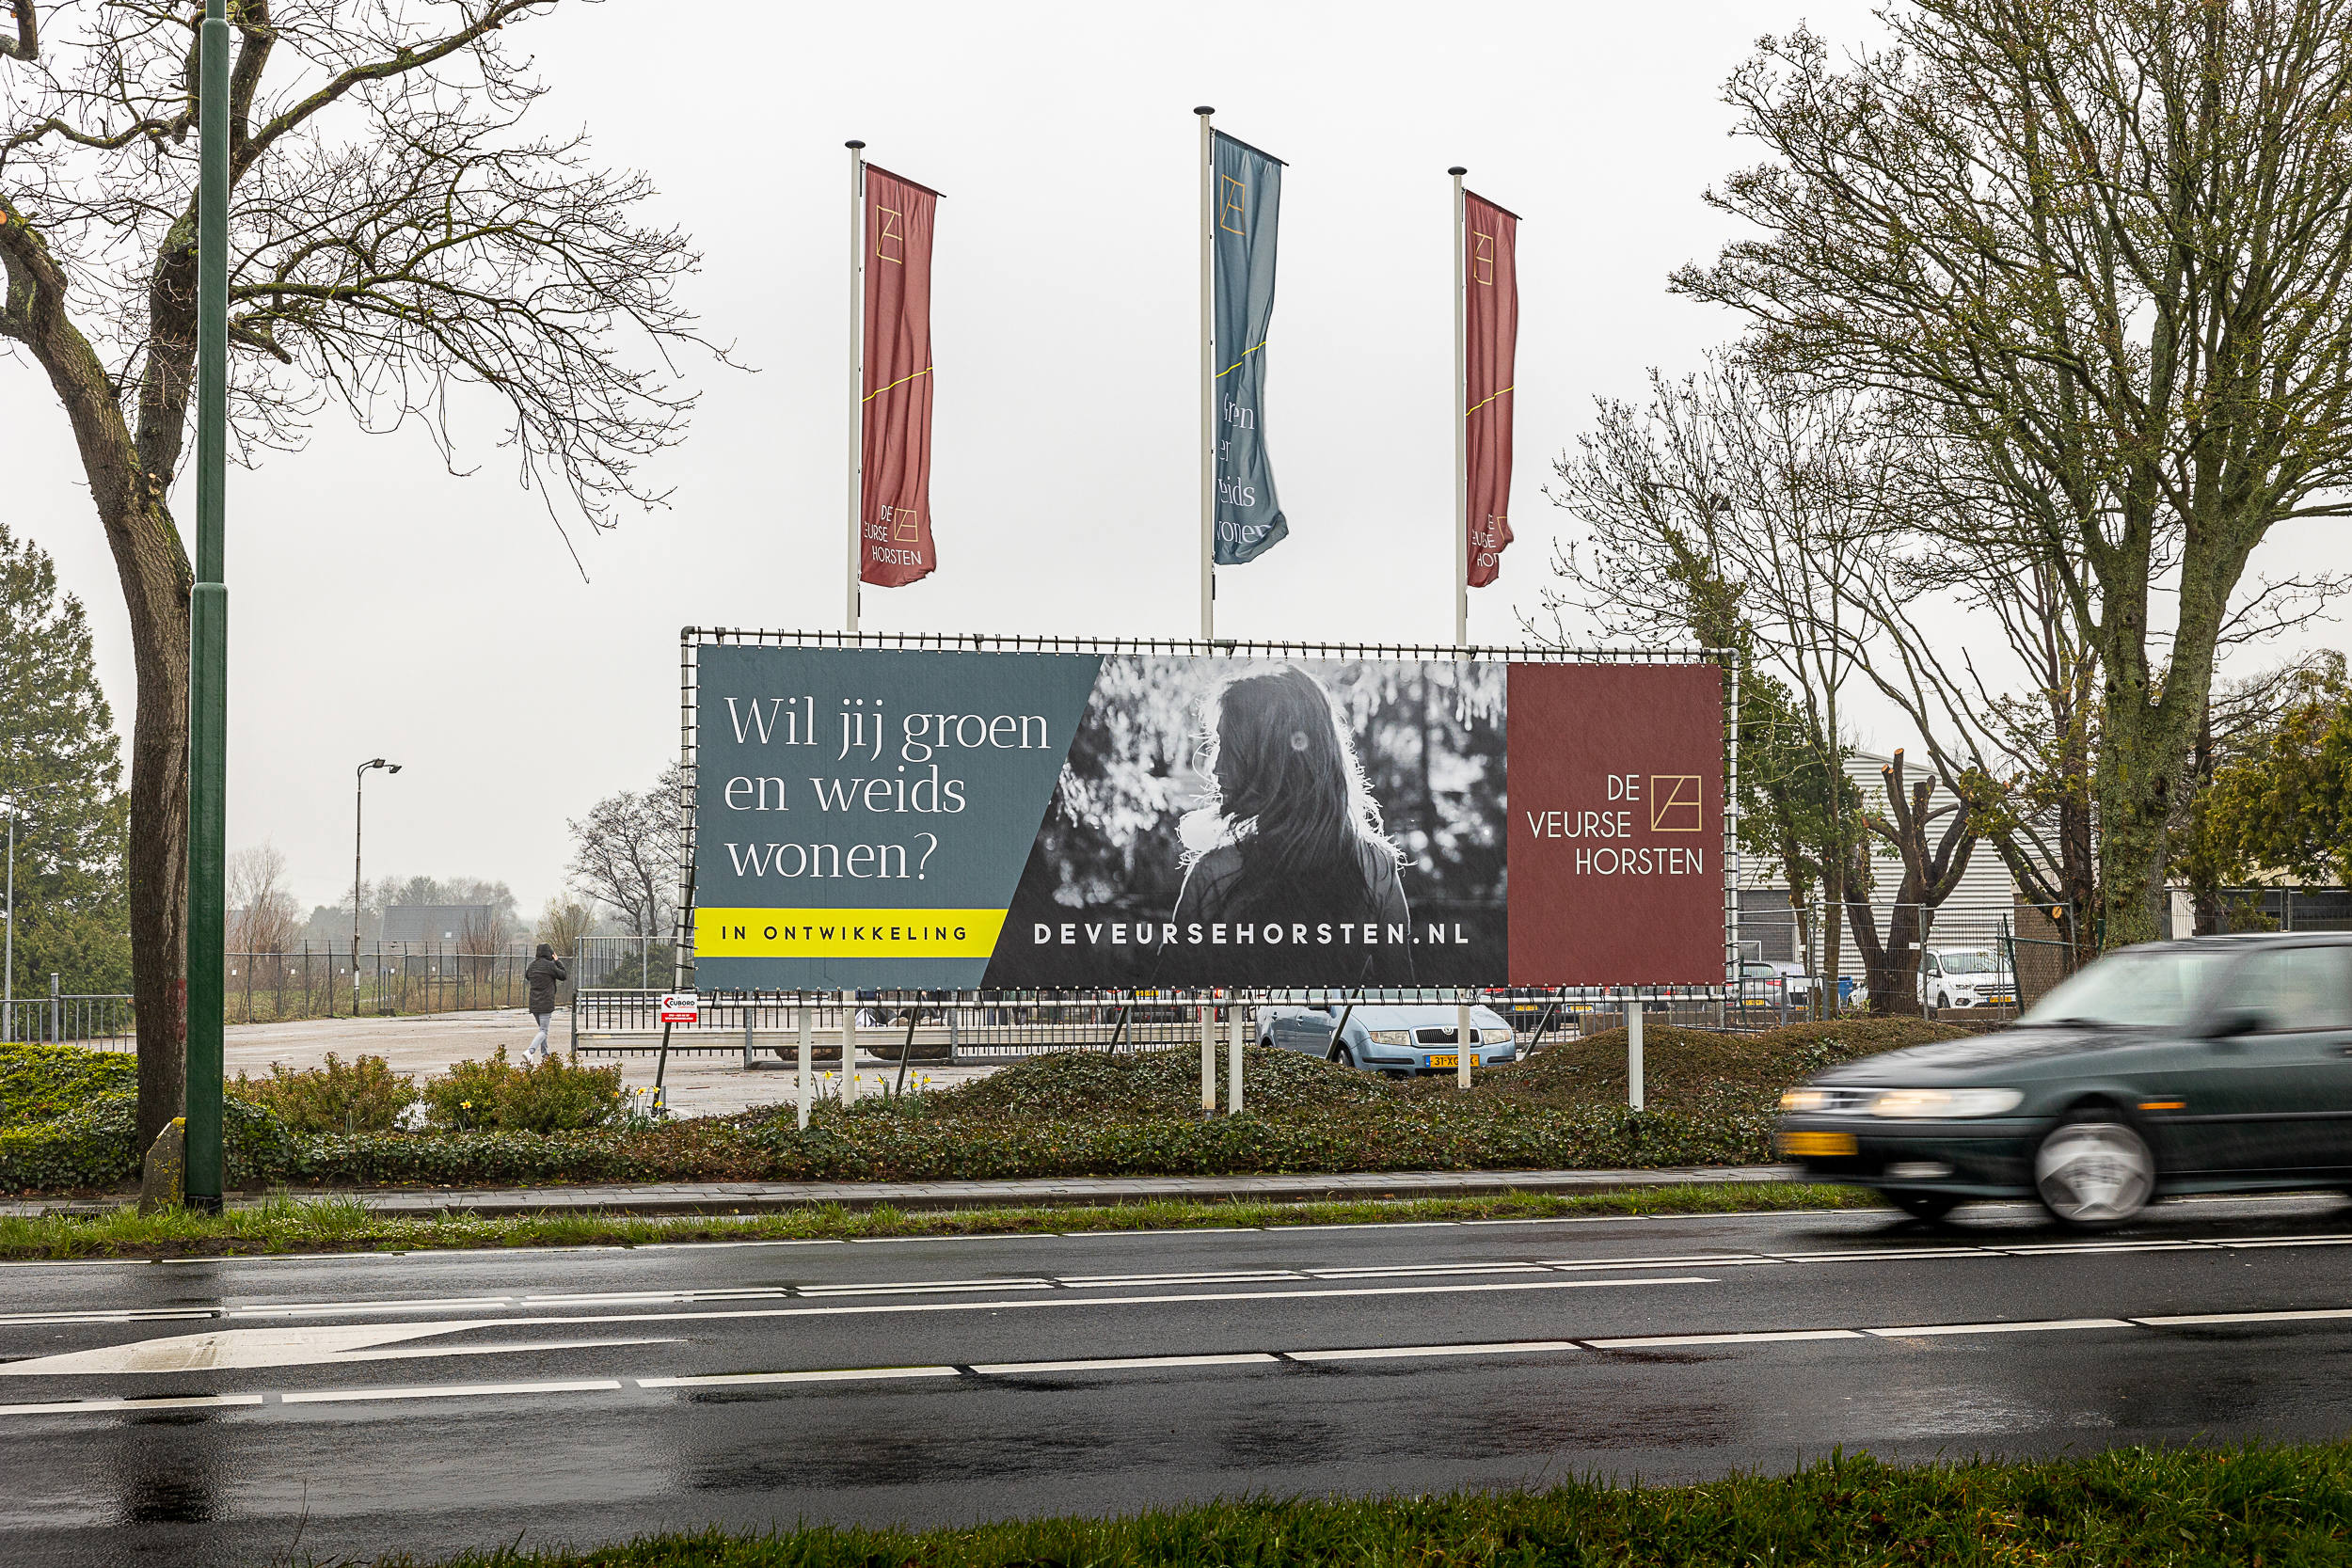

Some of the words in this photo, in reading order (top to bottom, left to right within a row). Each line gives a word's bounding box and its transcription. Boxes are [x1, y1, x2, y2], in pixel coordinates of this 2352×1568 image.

[1218, 476, 1255, 507] eids
[882, 504, 894, 522] DE
[865, 521, 888, 543] EURSE
[872, 546, 922, 565] HORSTEN
[723, 695, 818, 746] Wil
[837, 698, 883, 762] jij
[900, 711, 1052, 763] groen
[724, 776, 788, 811] en
[808, 765, 966, 814] weids
[1608, 774, 1640, 801] DE
[1526, 811, 1631, 839] VEURSE
[723, 832, 938, 880] wonen?
[1576, 847, 1704, 875] HORSTEN
[722, 926, 746, 940] IN
[763, 926, 967, 941] ONTWIKKELING
[1034, 923, 1469, 944] DEVEURSEHORSTEN.NL
